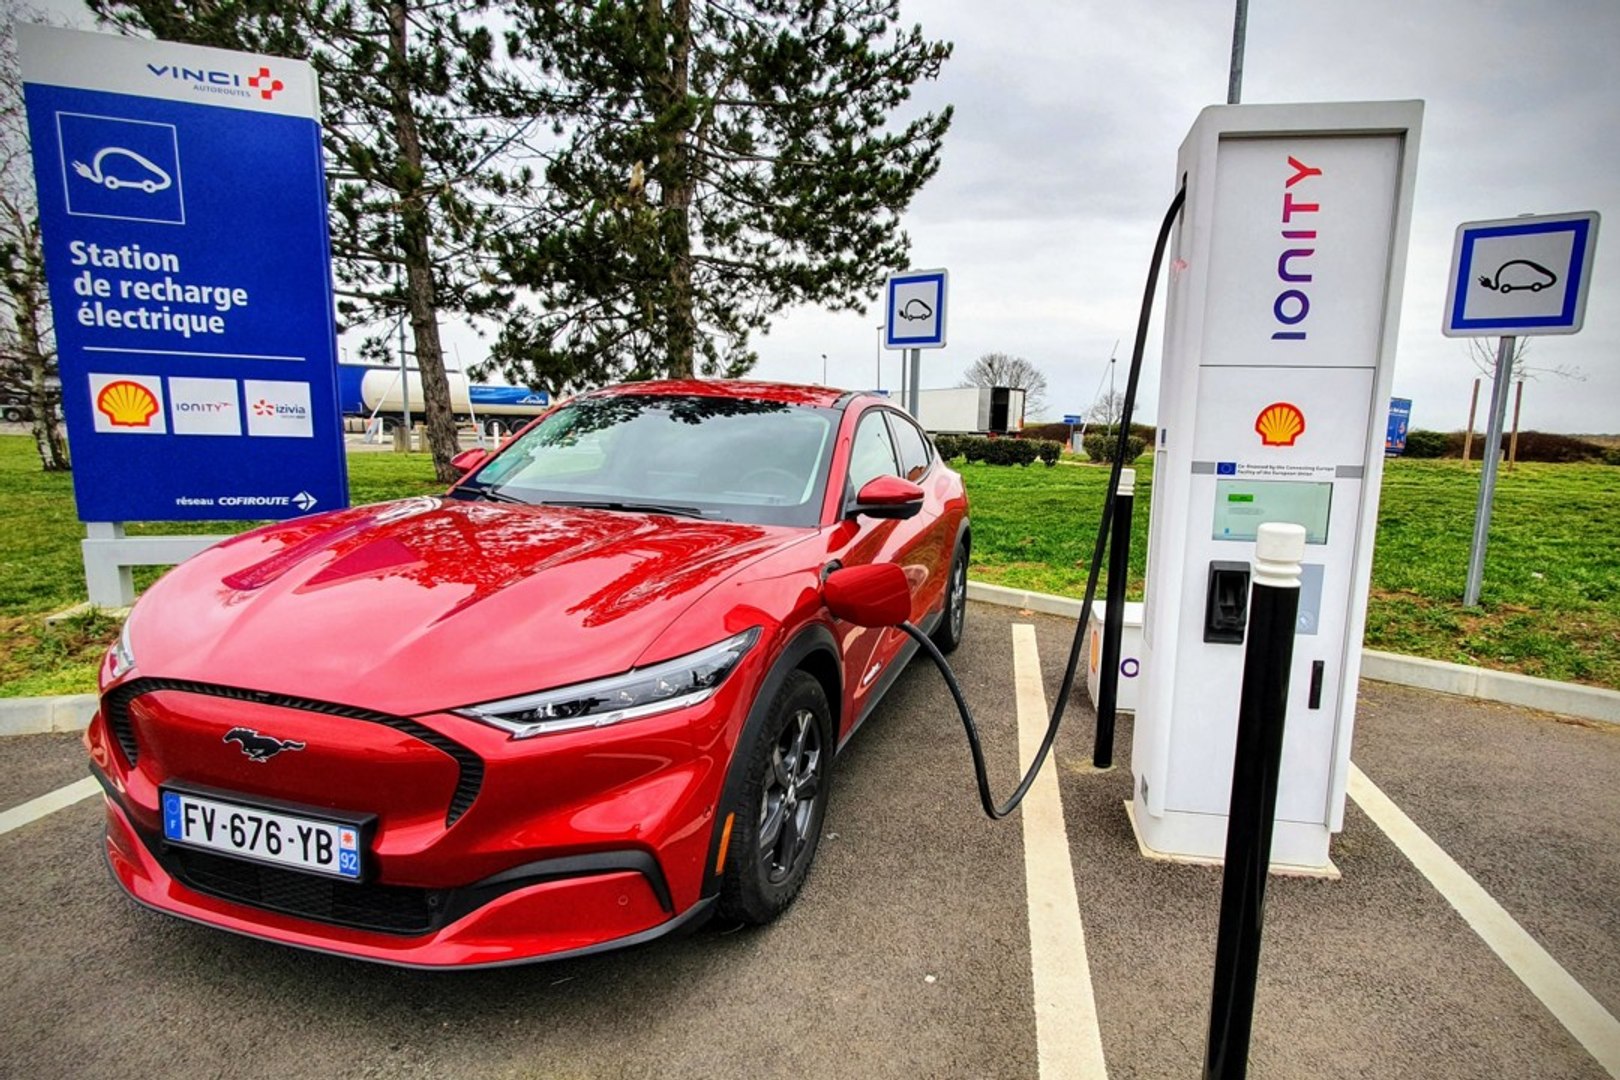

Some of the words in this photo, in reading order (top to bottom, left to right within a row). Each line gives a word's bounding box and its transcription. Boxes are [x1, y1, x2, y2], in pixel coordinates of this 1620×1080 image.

[147, 63, 240, 87] VINCI
[193, 84, 251, 98] AUTOROUTES
[69, 240, 180, 273] Station
[1271, 155, 1323, 341] IONITY
[73, 270, 111, 298] de
[120, 276, 248, 312] recharge
[77, 301, 225, 339] électrique
[175, 402, 233, 413] IONITY
[275, 404, 306, 414] izivia
[176, 496, 214, 506] réseau
[218, 496, 290, 506] COFIROUTE
[170, 820, 176, 830] F
[184, 802, 333, 865] FV-676-YB
[340, 853, 358, 871] 92
